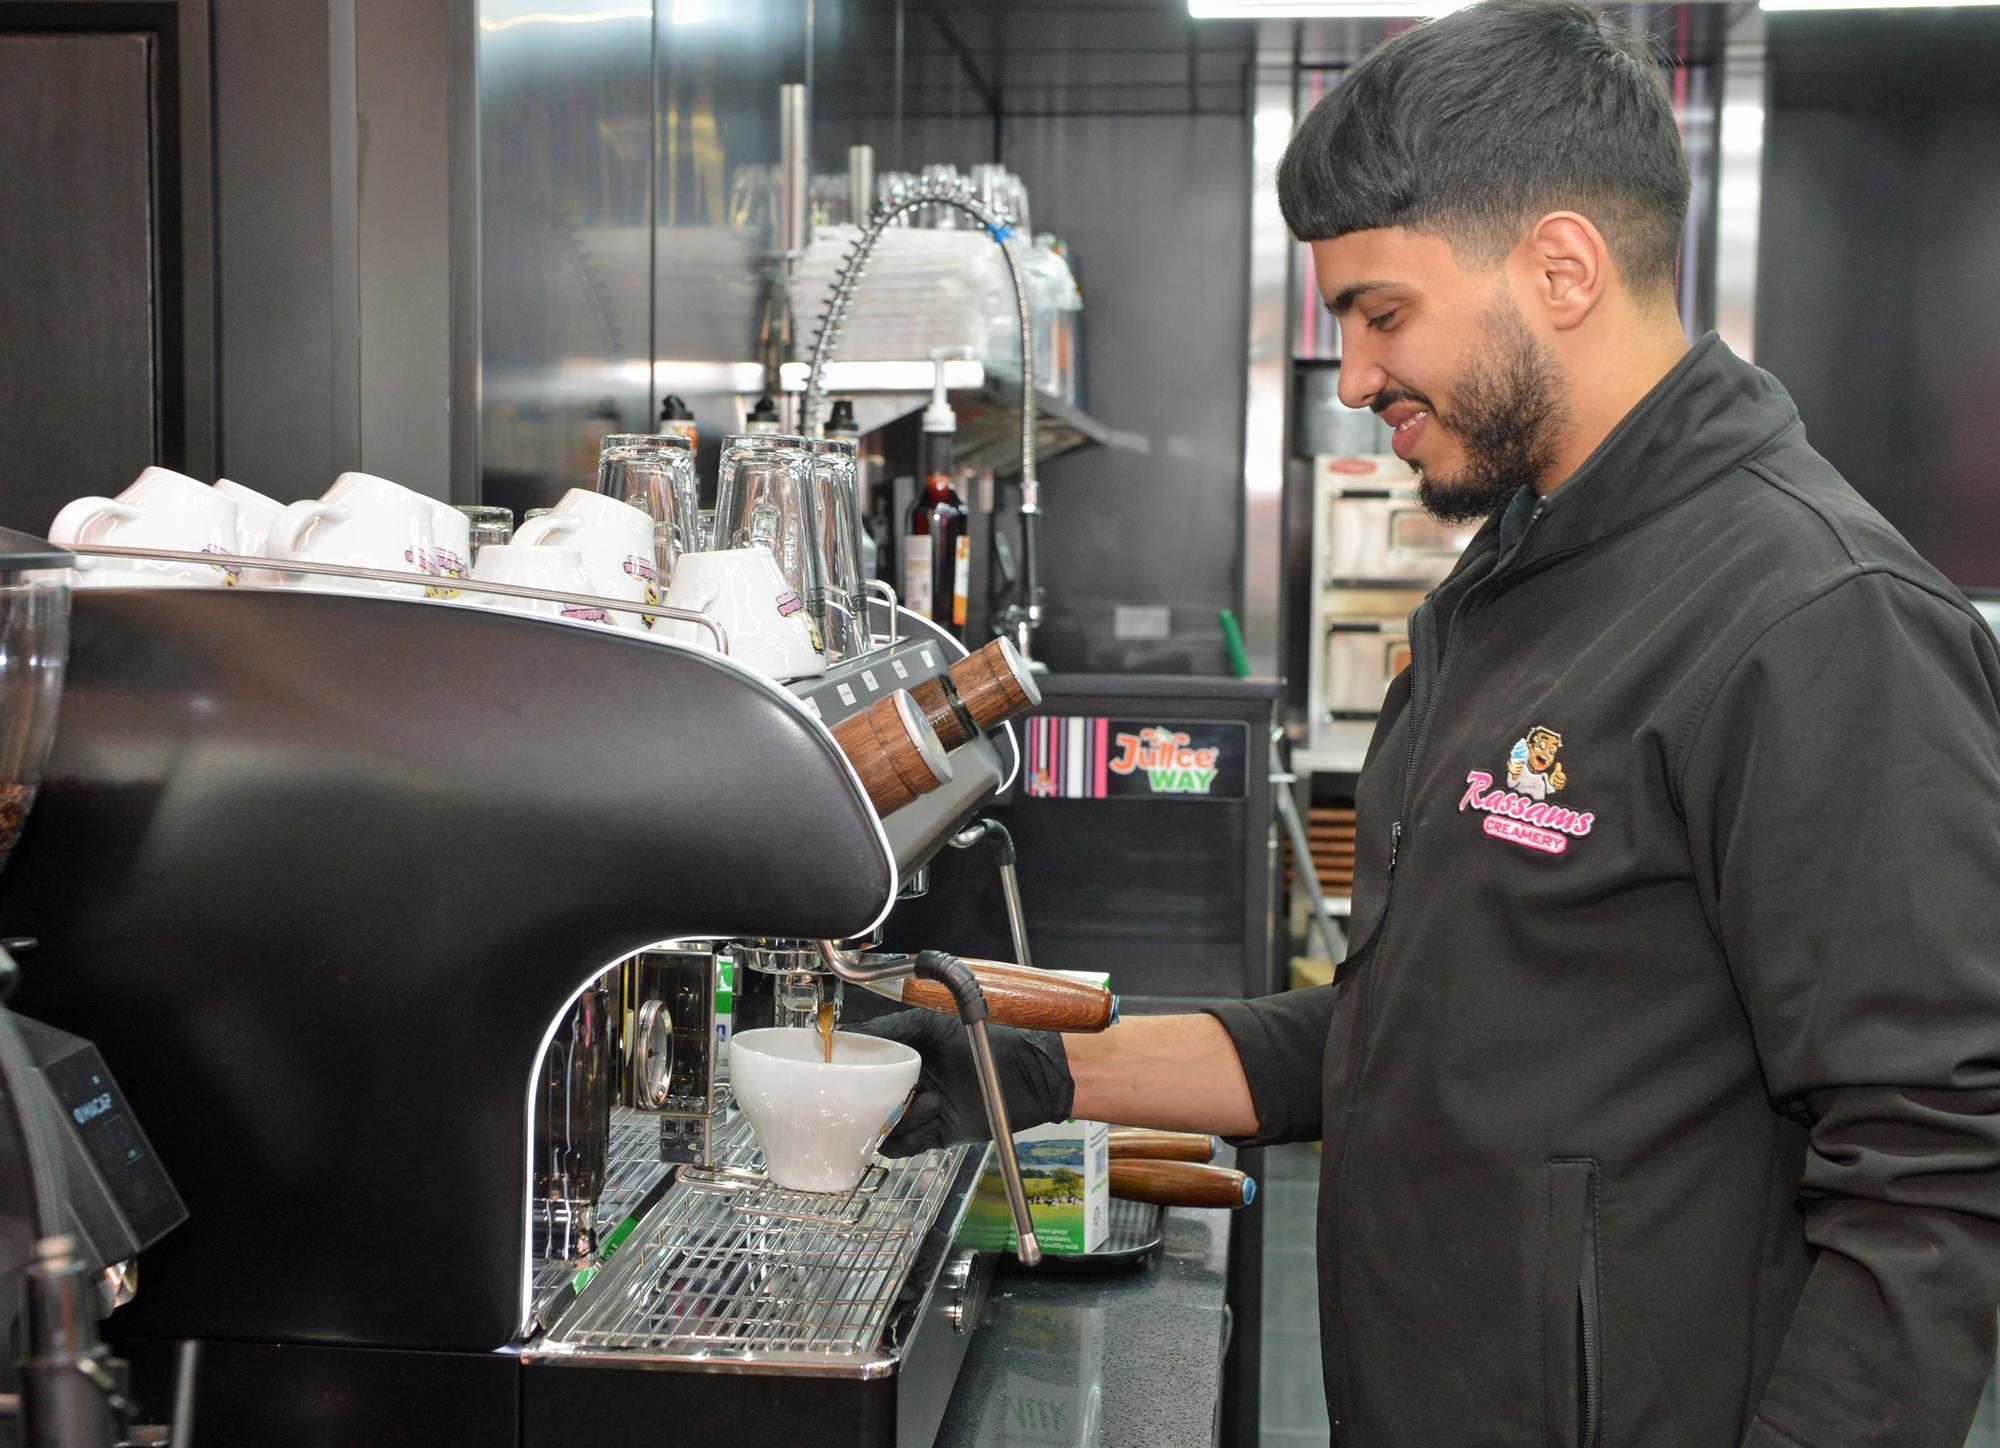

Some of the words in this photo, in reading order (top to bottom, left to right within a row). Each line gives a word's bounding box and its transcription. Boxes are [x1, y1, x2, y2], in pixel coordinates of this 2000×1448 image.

[1149, 769, 1216, 792] WAY
[1459, 770, 1595, 835] Rassams
[1485, 819, 1563, 849] CREAMERY
